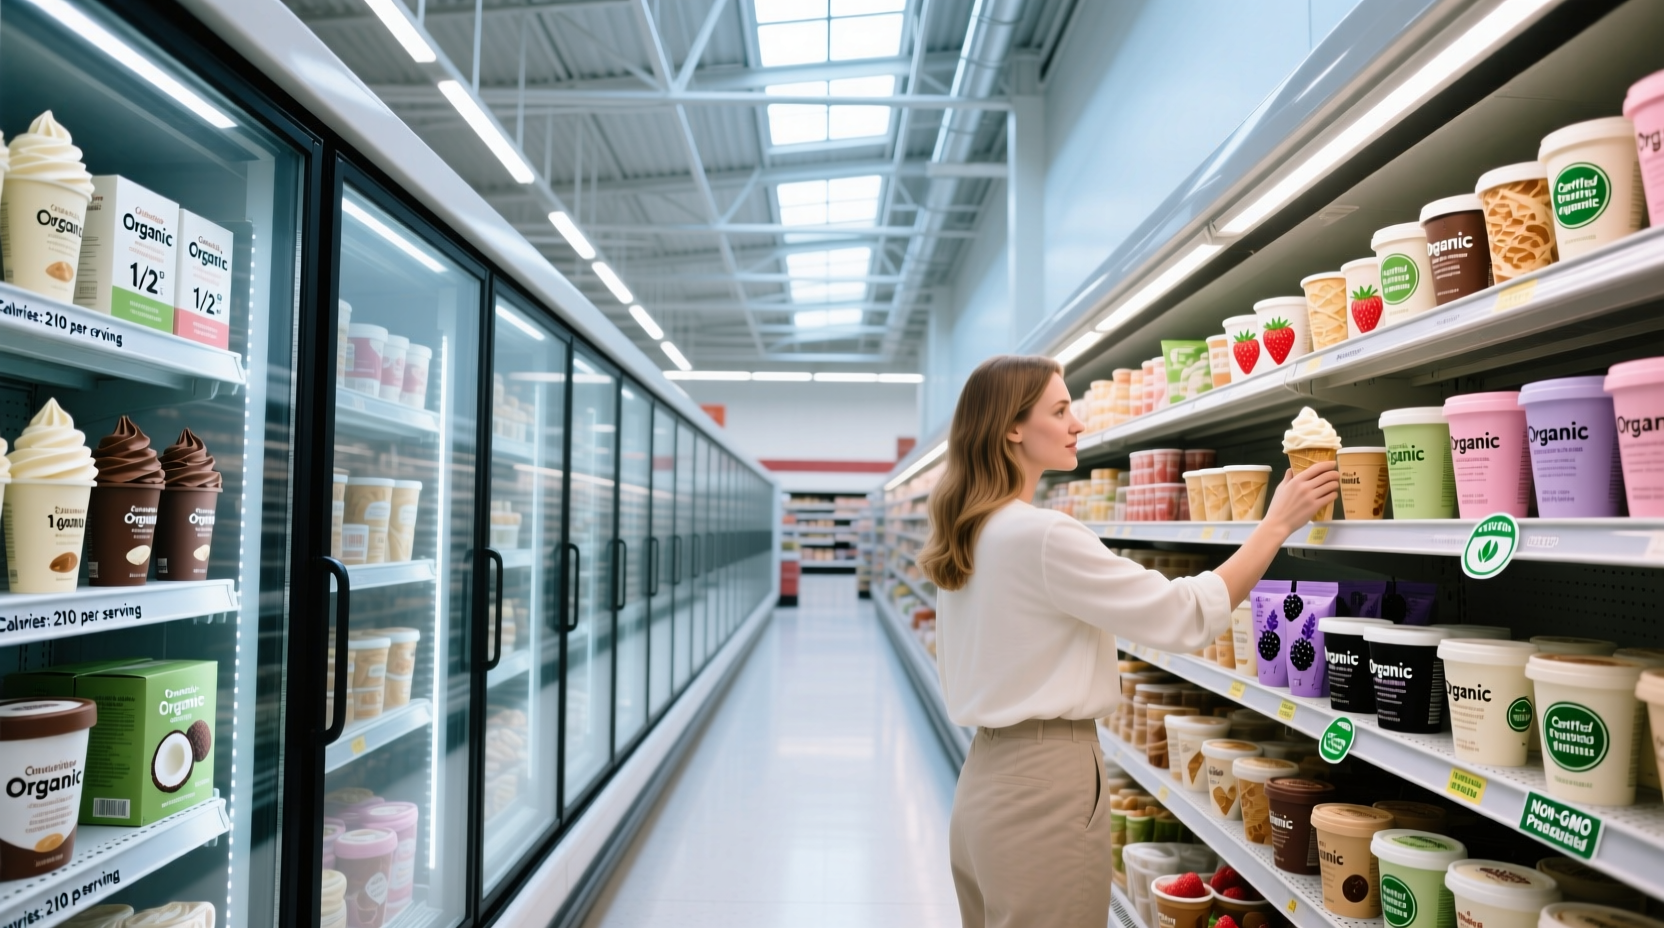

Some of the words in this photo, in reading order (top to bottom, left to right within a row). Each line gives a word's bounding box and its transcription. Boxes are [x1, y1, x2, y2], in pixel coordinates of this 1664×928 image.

[122, 212, 174, 248] Organic
[129, 261, 159, 295] 1/2
[45, 311, 67, 330] 210
[53, 609, 77, 627] 210
[80, 610, 99, 627] per
[102, 602, 142, 620] serving
[5, 769, 82, 800] Organic
[46, 892, 69, 915] 210
